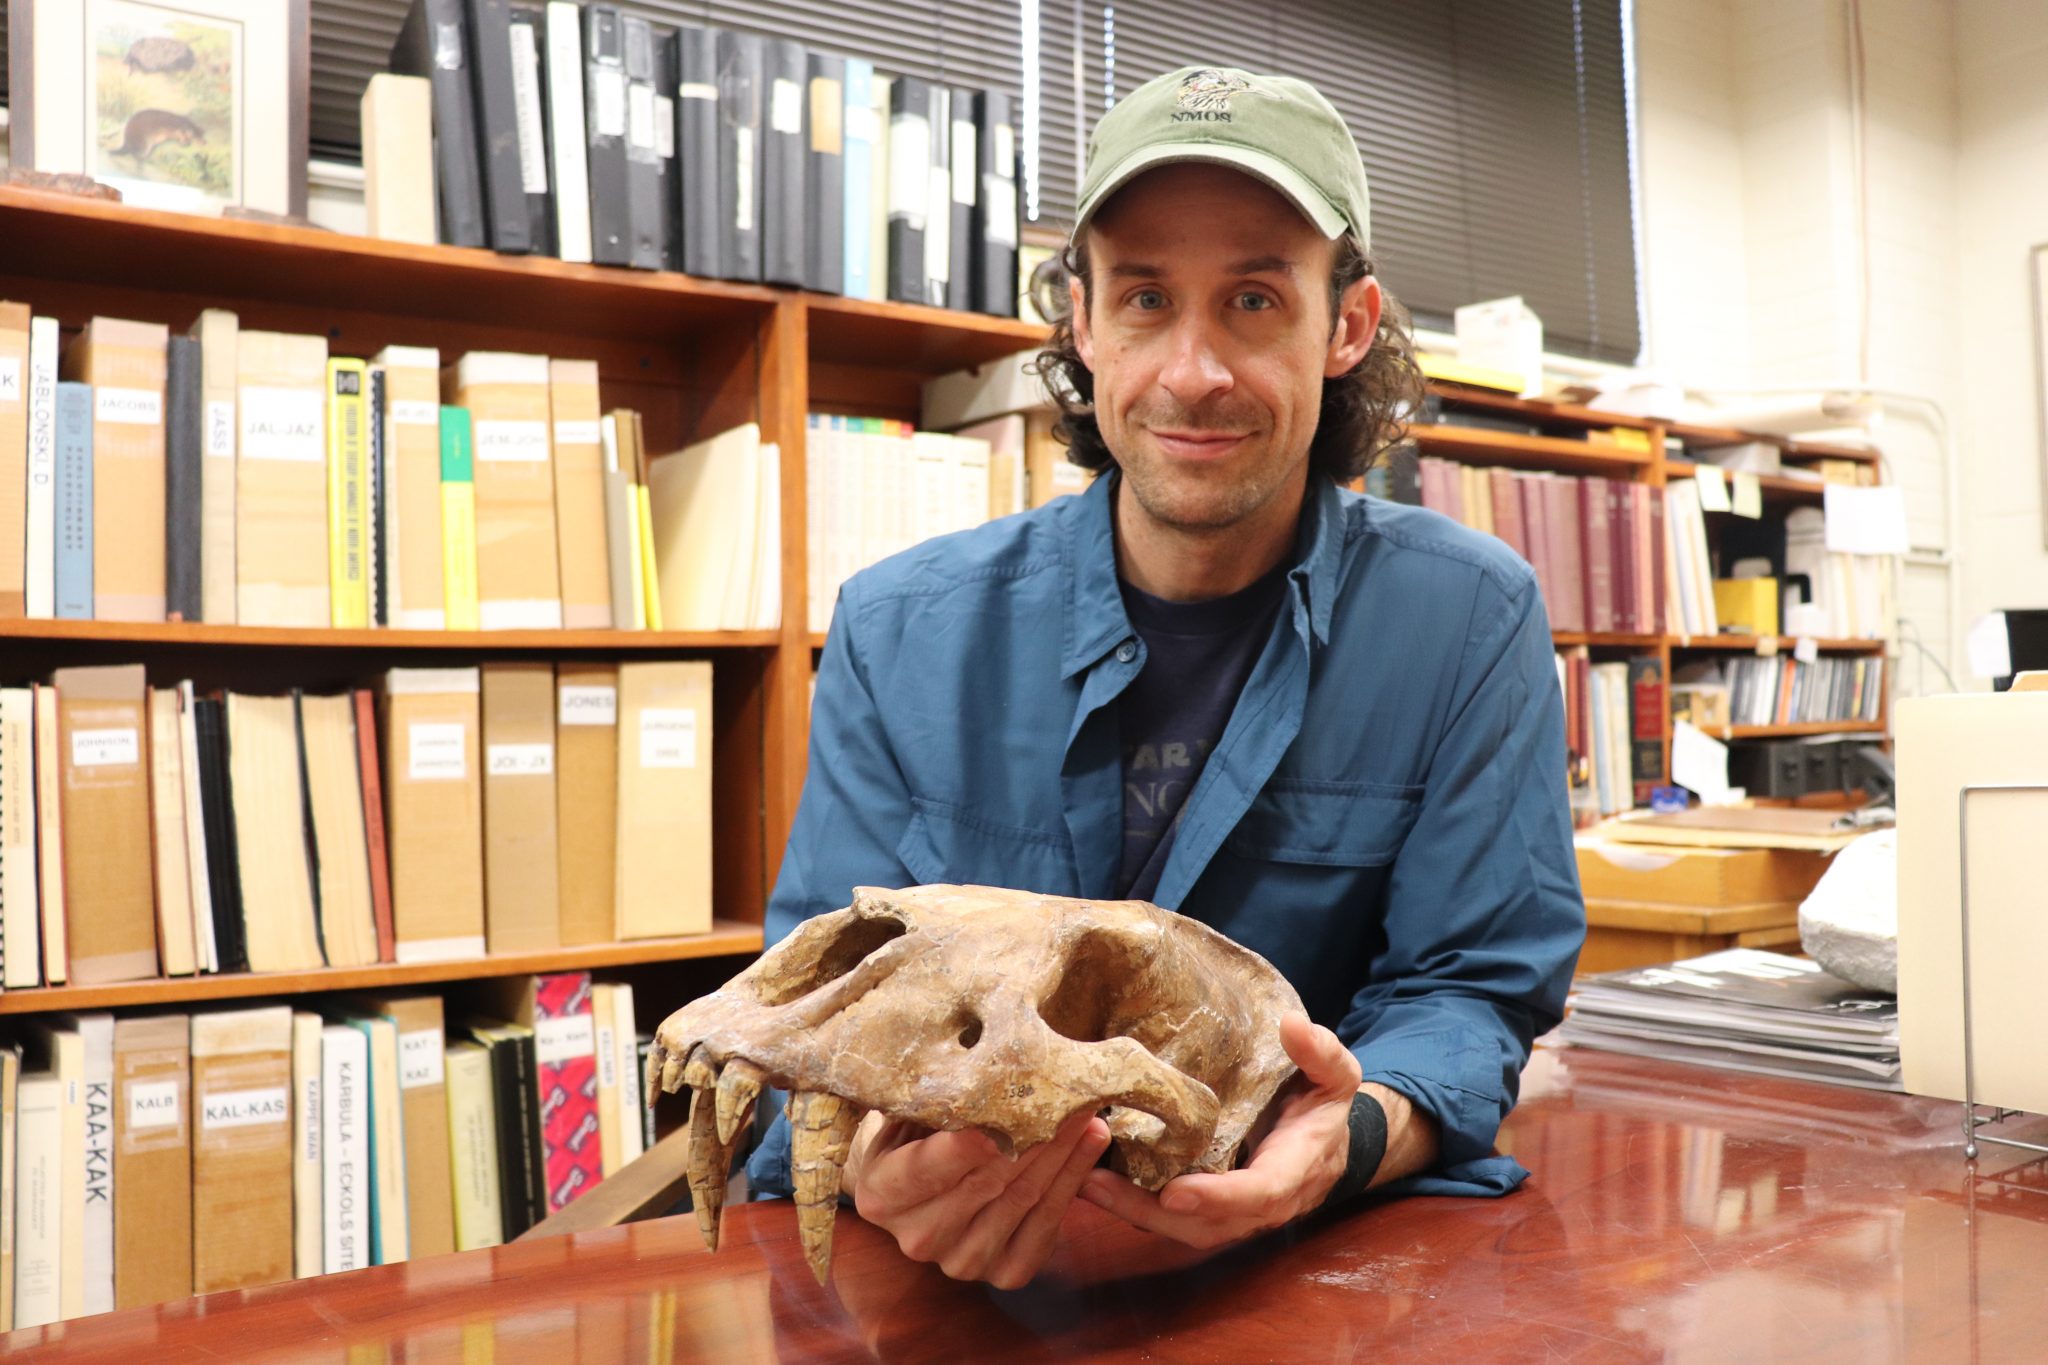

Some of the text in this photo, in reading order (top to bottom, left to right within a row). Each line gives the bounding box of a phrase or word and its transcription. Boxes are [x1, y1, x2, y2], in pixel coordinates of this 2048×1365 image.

[100, 397, 157, 413] JACOBS
[212, 408, 227, 450] JASS
[563, 696, 616, 710] JONES
[136, 1095, 174, 1111] KALB
[206, 1099, 285, 1121] KAL-KAS
[338, 1062, 353, 1142] KARBULA
[86, 1082, 108, 1204] KAA-KAK
[338, 1162, 354, 1231] ECKOLS
[340, 1235, 354, 1271] SITE
